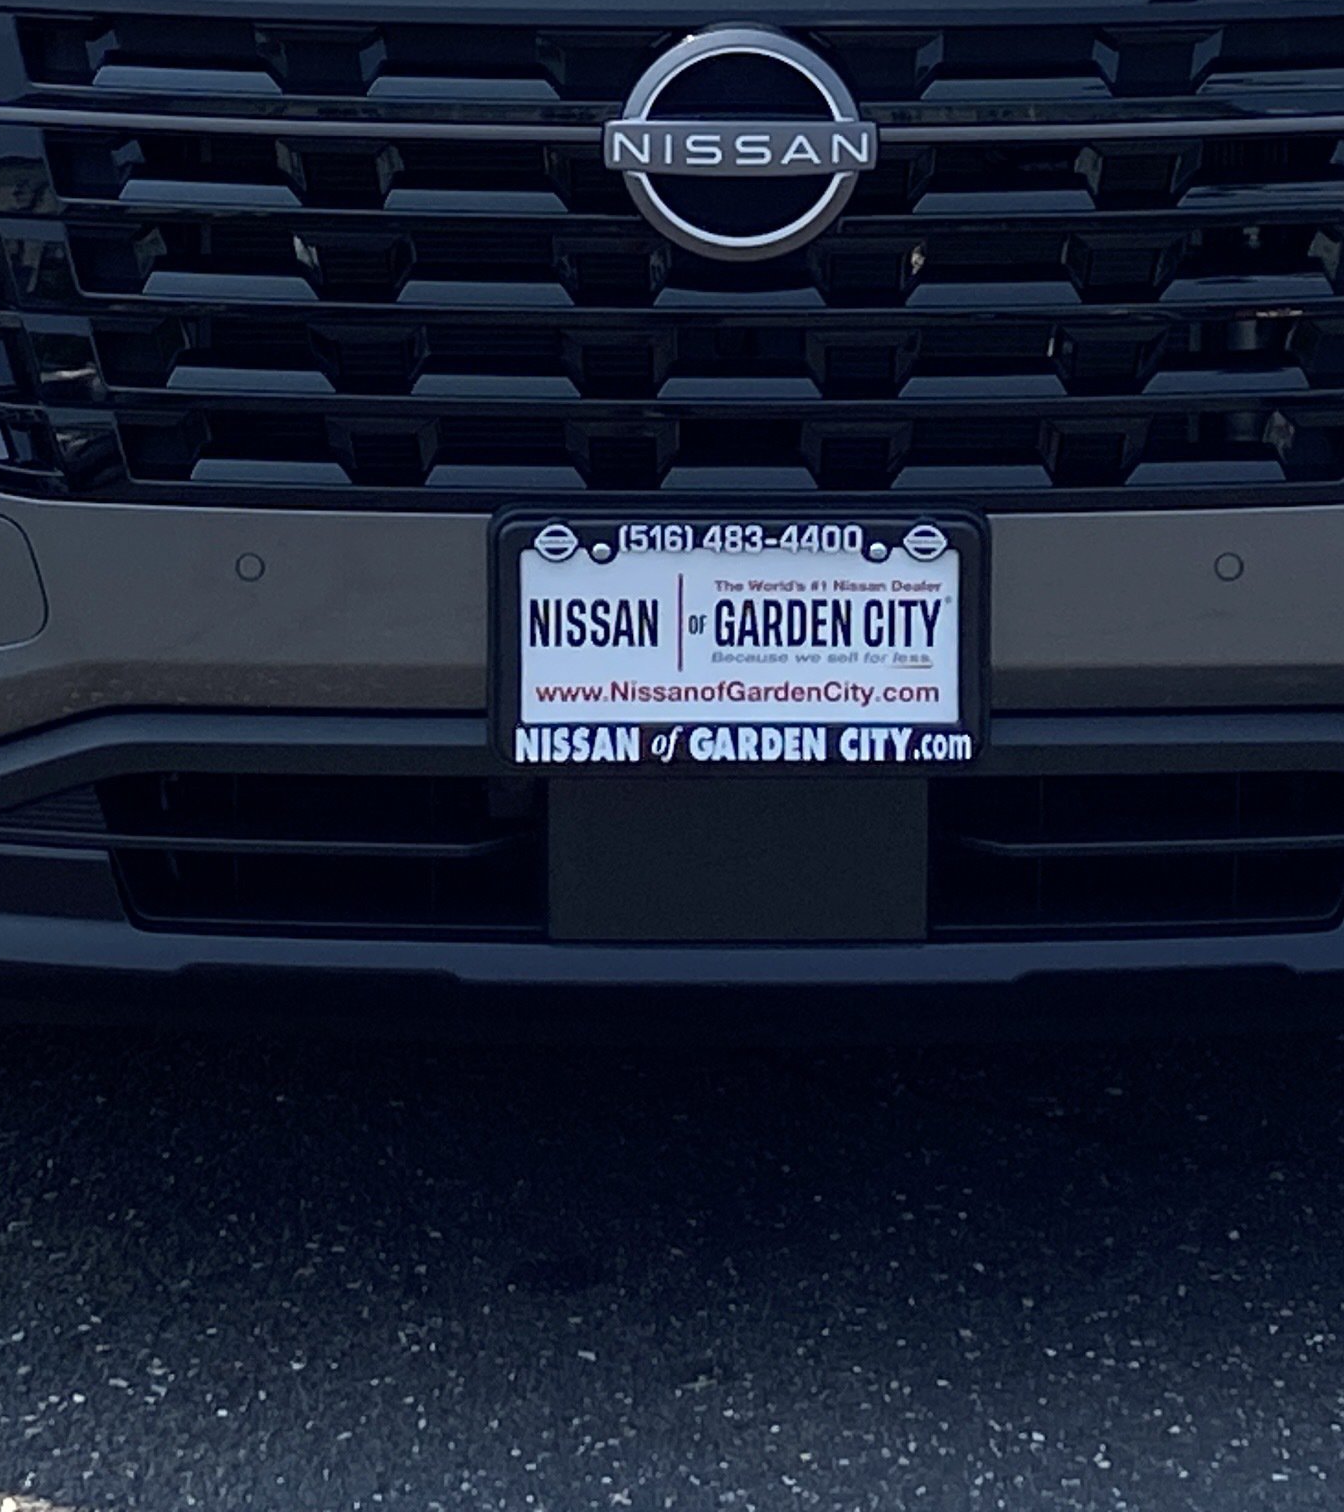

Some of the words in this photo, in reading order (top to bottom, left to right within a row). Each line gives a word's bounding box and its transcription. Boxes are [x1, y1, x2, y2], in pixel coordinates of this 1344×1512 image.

[612, 132, 869, 165] NISSAN
[618, 524, 693, 553] (516)
[702, 524, 863, 553] 483-4400
[714, 580, 744, 592] The
[748, 580, 806, 592] World's
[833, 580, 887, 592] Nissan
[891, 580, 942, 592] Dealer
[529, 598, 659, 648] NISSAN
[688, 614, 707, 635] OF
[714, 598, 852, 648] GARDEN
[864, 598, 942, 648] CITY
[711, 651, 789, 664] Because
[795, 653, 822, 664] we
[827, 651, 859, 664] sell
[863, 651, 888, 664] for
[535, 680, 940, 706] www.NissanofGardenCity.com
[515, 726, 641, 763] NISSAN
[651, 725, 684, 763] of
[689, 726, 826, 762] GARDEN
